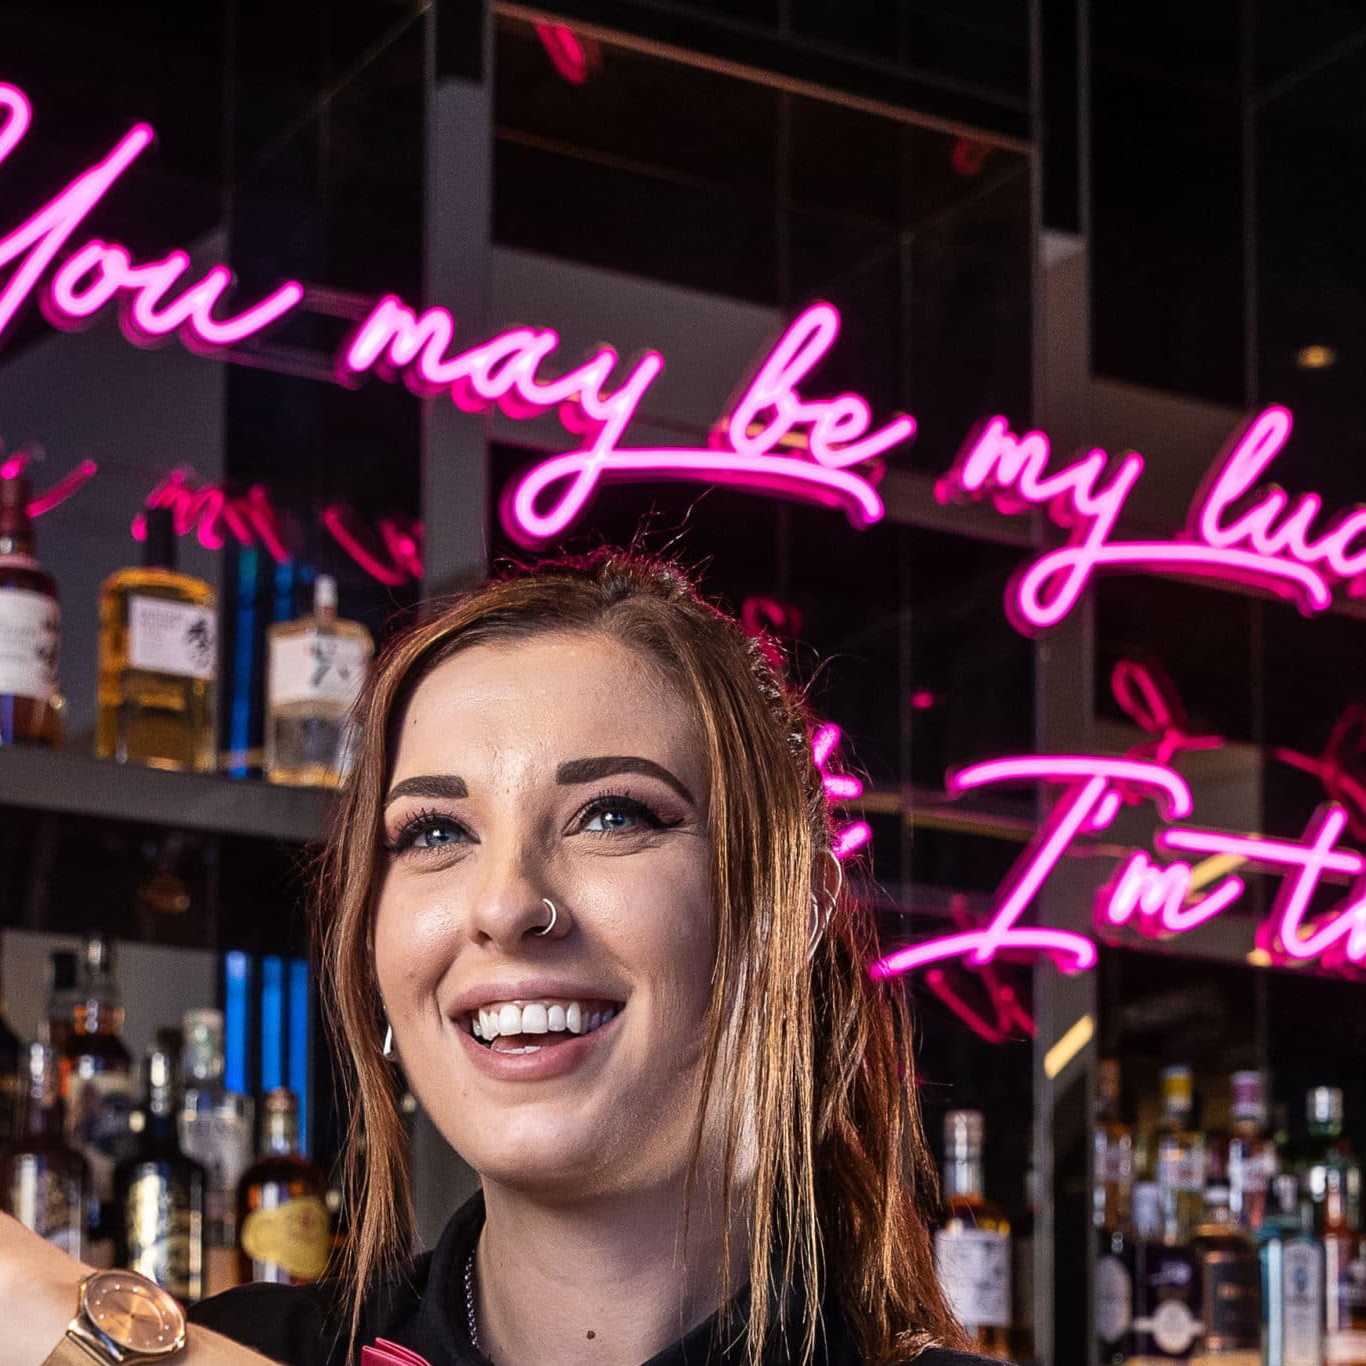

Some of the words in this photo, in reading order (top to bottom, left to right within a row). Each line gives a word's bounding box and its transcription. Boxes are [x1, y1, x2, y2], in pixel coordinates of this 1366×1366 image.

[341, 290, 887, 542] may
[723, 296, 921, 474] be
[955, 408, 1333, 632] my
[869, 750, 1249, 982] I'm
